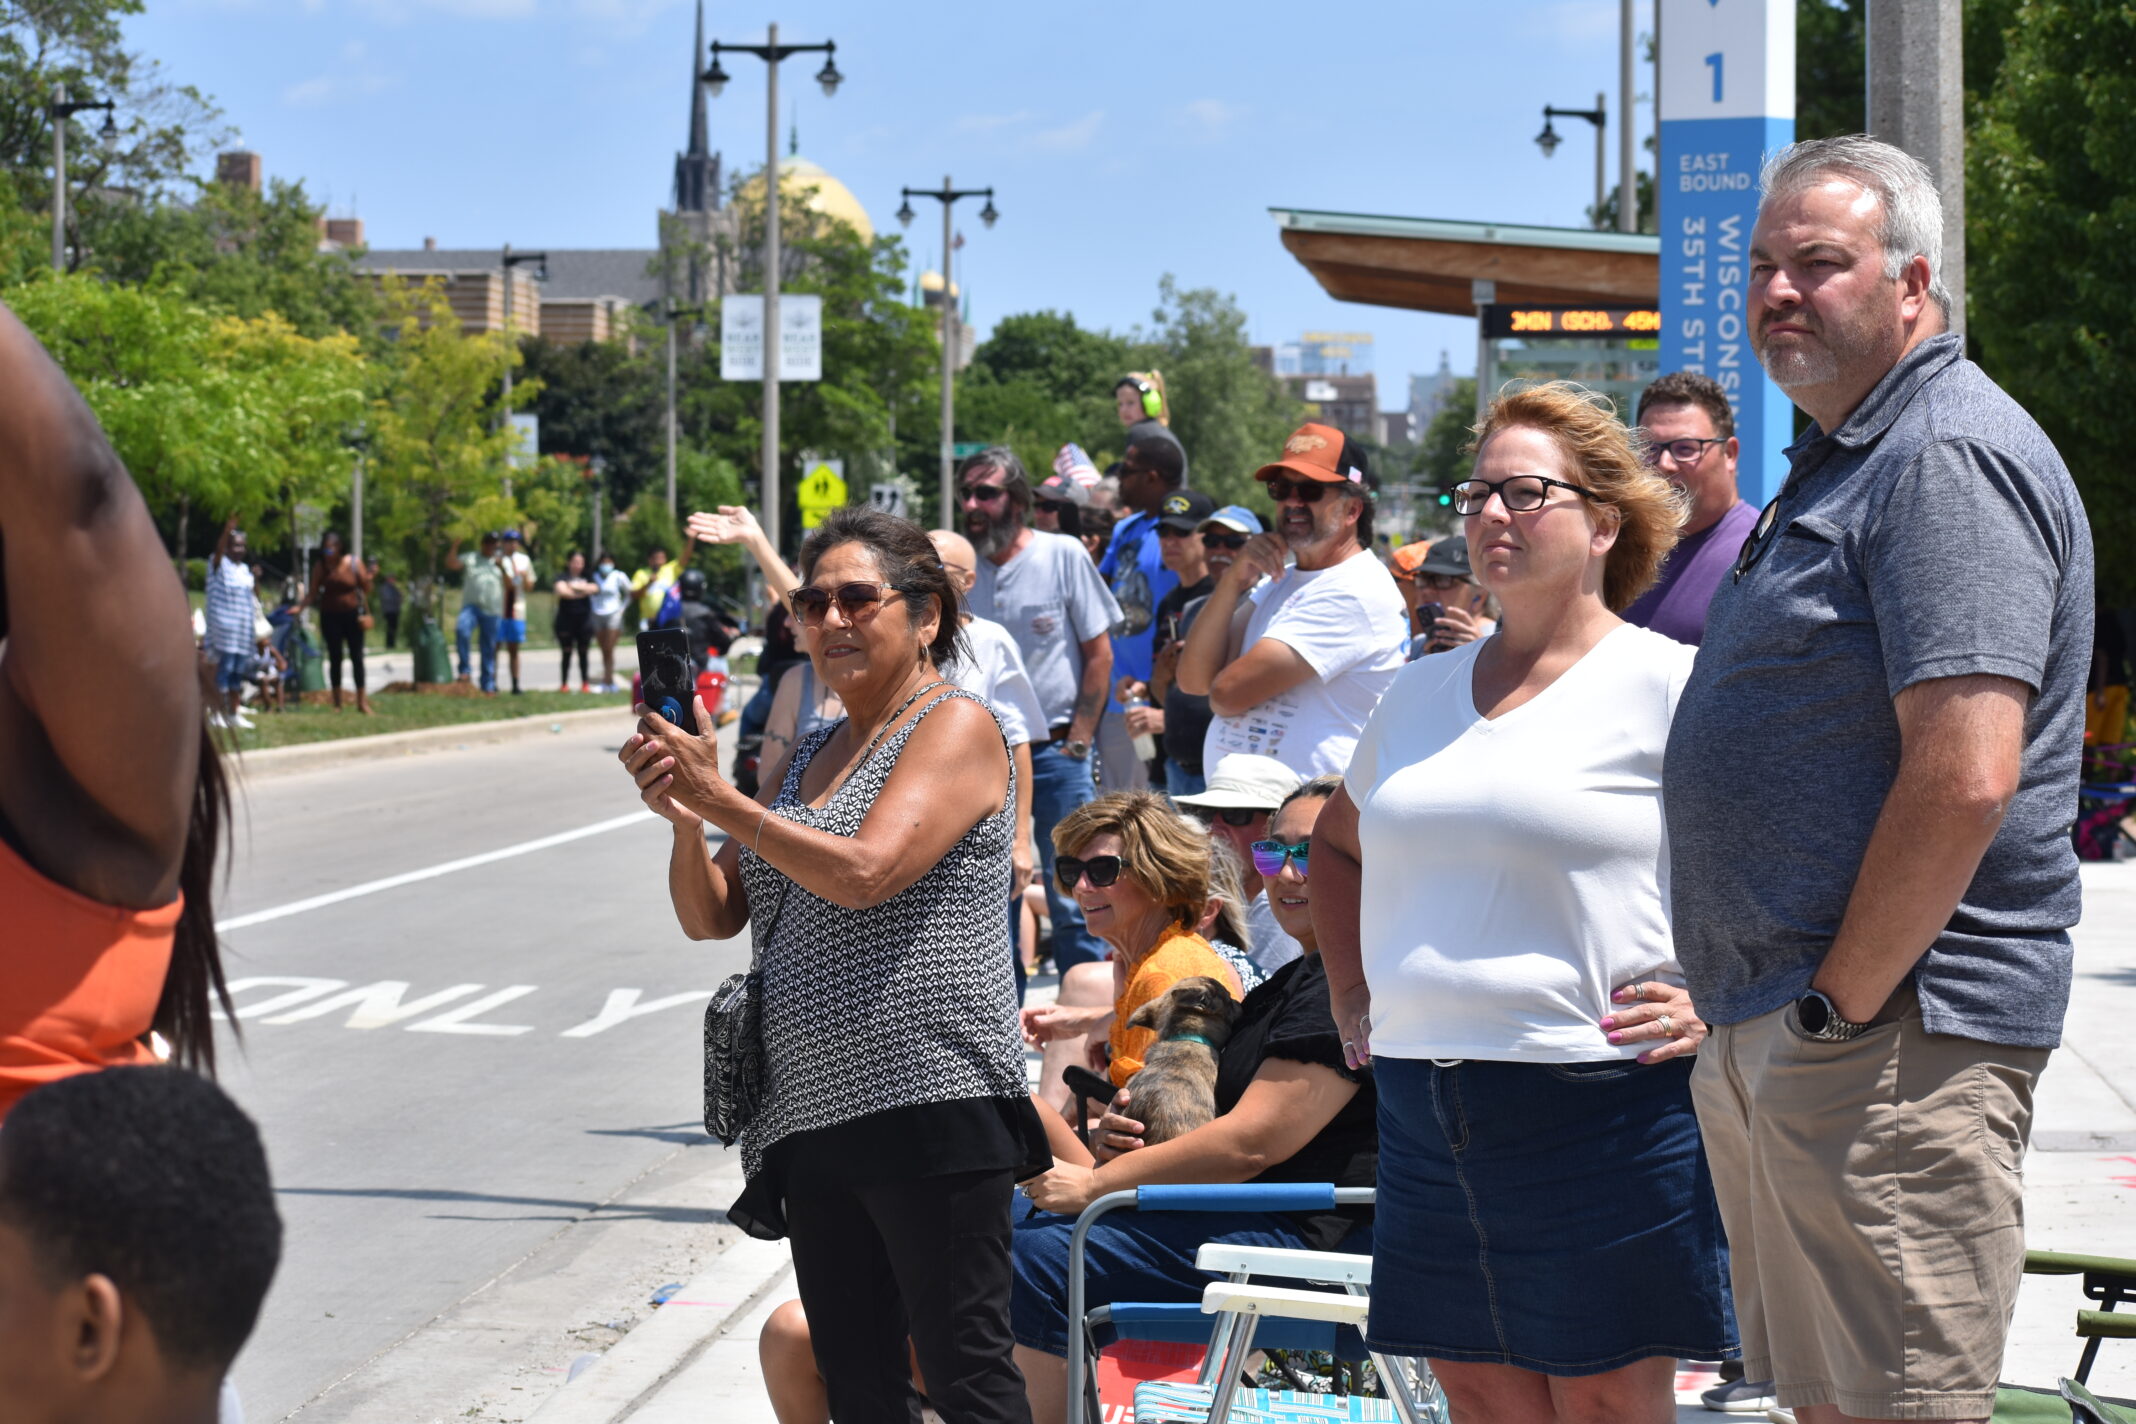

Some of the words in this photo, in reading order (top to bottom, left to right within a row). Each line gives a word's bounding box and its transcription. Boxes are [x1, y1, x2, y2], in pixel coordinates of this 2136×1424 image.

[1704, 52, 1723, 103] 1
[1679, 153, 1729, 172] EAST
[1679, 173, 1750, 192] BOUND
[1682, 216, 1706, 306] 35TH
[207, 976, 713, 1038] ONLY
